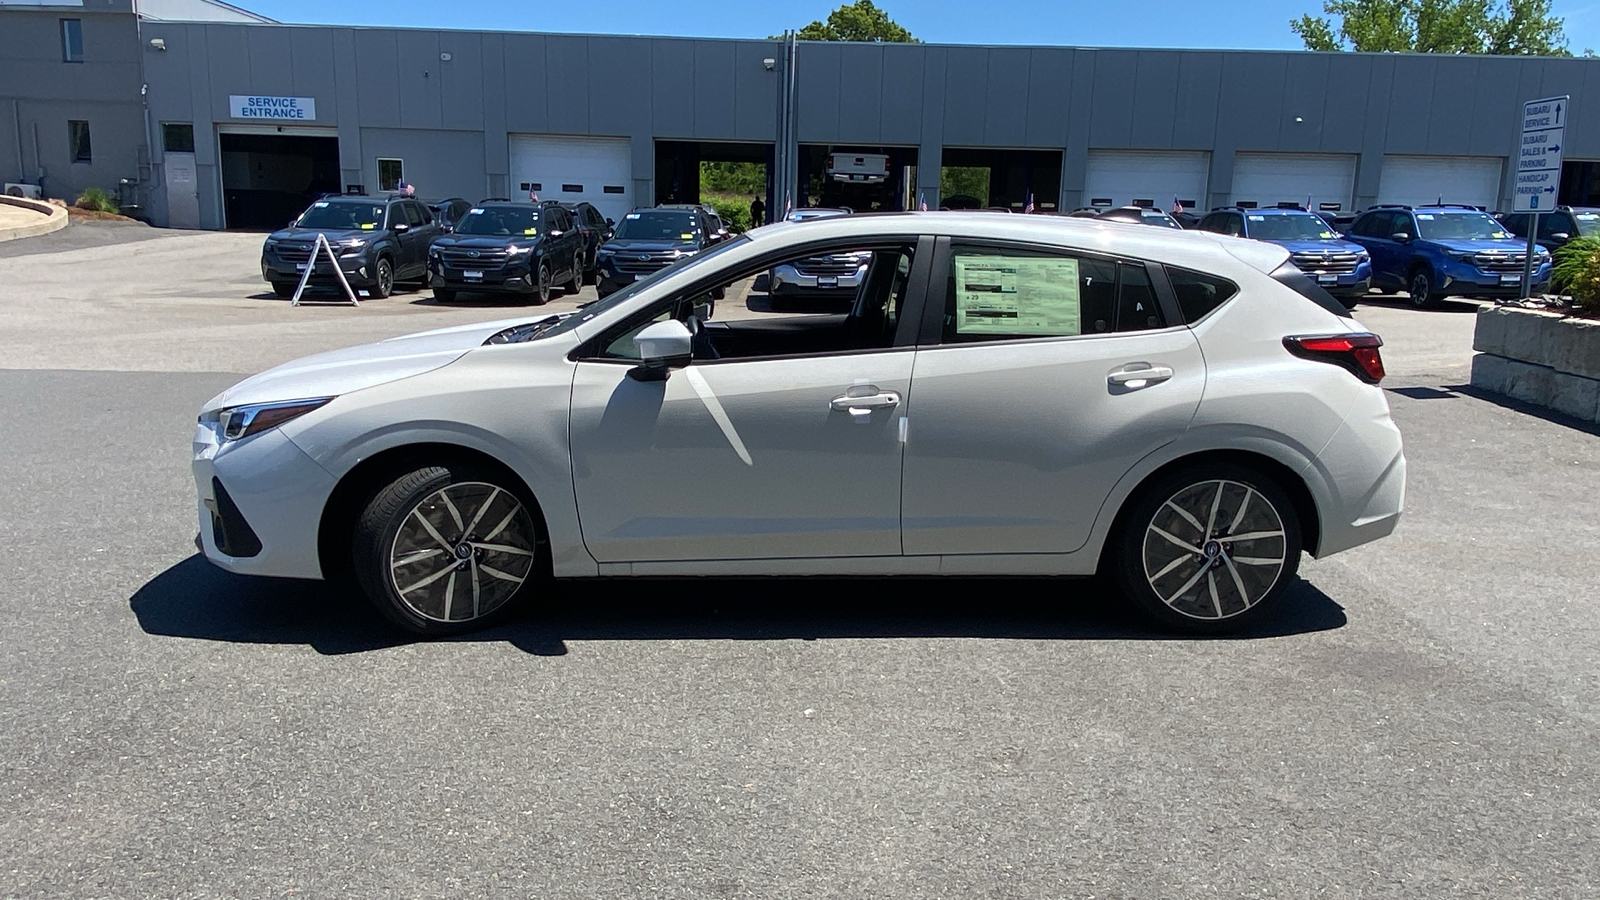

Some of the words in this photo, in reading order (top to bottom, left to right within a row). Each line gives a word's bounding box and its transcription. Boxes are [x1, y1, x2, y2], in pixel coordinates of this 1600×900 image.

[248, 97, 297, 108] SERVICE
[242, 107, 304, 118] ENTRANCE
[1526, 105, 1550, 116] SUBARU
[1525, 117, 1550, 127] SERVICE
[1523, 135, 1548, 145] SUBARU
[1522, 147, 1540, 156] SALES
[1541, 147, 1546, 155] &
[1520, 159, 1547, 168] PARKING
[1519, 174, 1549, 182] HANDICAP
[1517, 186, 1543, 194] PARKING
